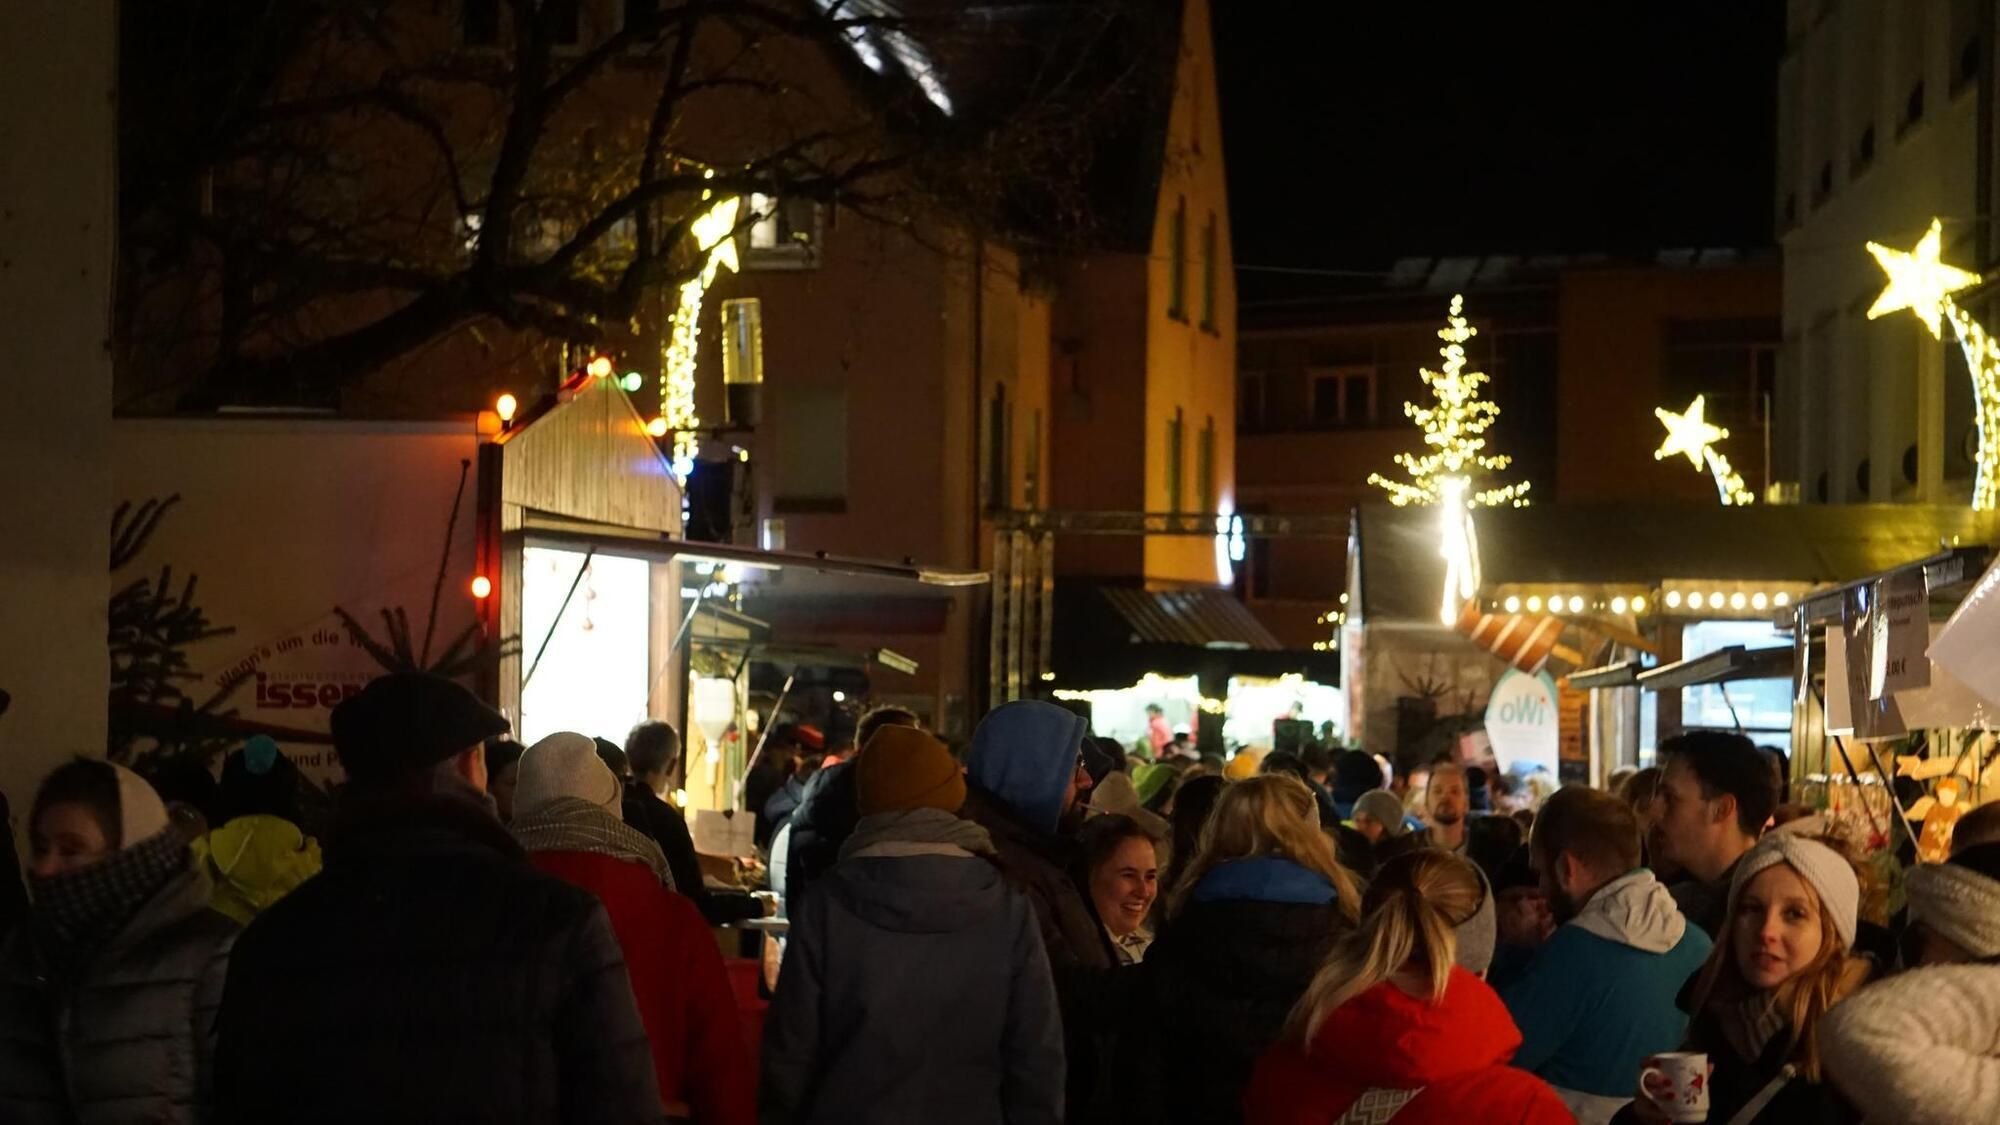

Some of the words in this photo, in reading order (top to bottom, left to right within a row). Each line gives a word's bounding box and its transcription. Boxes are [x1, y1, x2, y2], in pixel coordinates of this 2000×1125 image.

[276, 636, 303, 653] um
[312, 629, 339, 646] die
[1500, 693, 1546, 727] oWi
